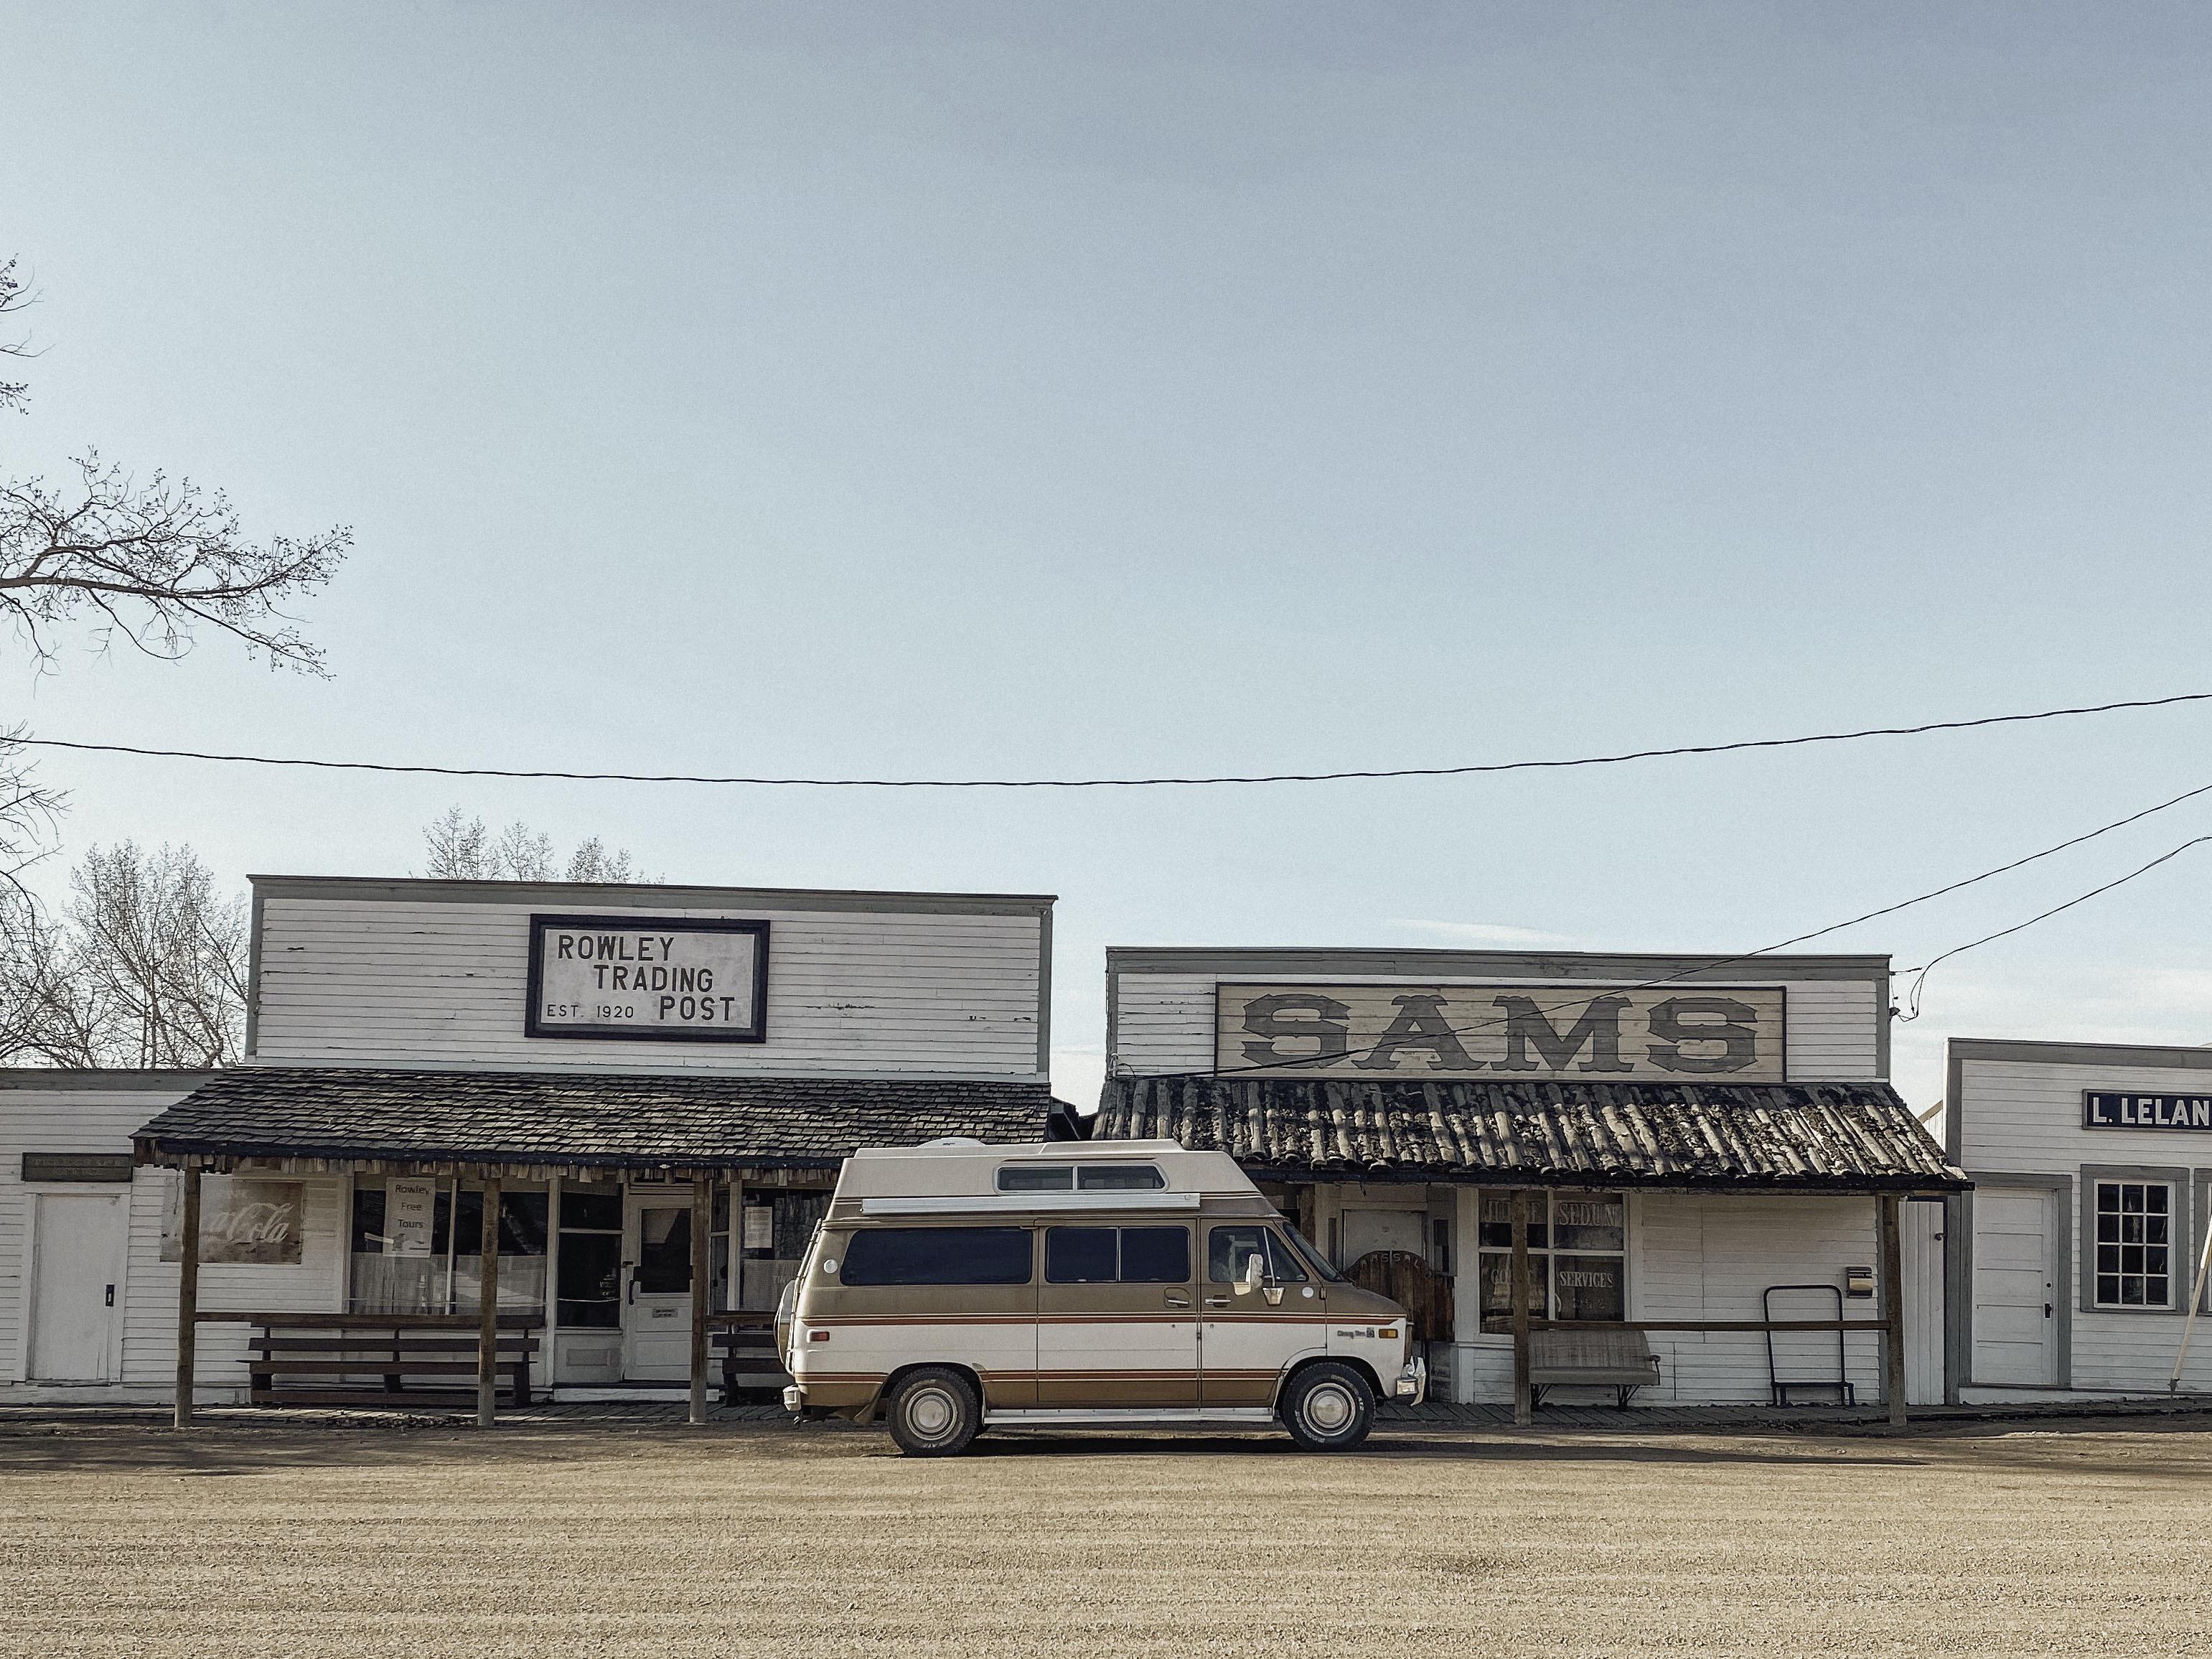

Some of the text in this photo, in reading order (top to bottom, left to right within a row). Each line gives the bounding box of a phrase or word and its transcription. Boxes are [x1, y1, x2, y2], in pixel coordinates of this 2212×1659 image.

[558, 935, 675, 961] ROWLEY
[594, 965, 713, 992] TRADING
[547, 1004, 634, 1019] EST. 1920
[659, 996, 735, 1021] POST
[1241, 994, 1758, 1073] SAMS
[2093, 1097, 2210, 1126] L. LELAN
[395, 1184, 429, 1195] Rowley
[401, 1202, 422, 1211] Free
[397, 1219, 423, 1228] Tours
[1559, 1271, 1614, 1288] SERVICES
